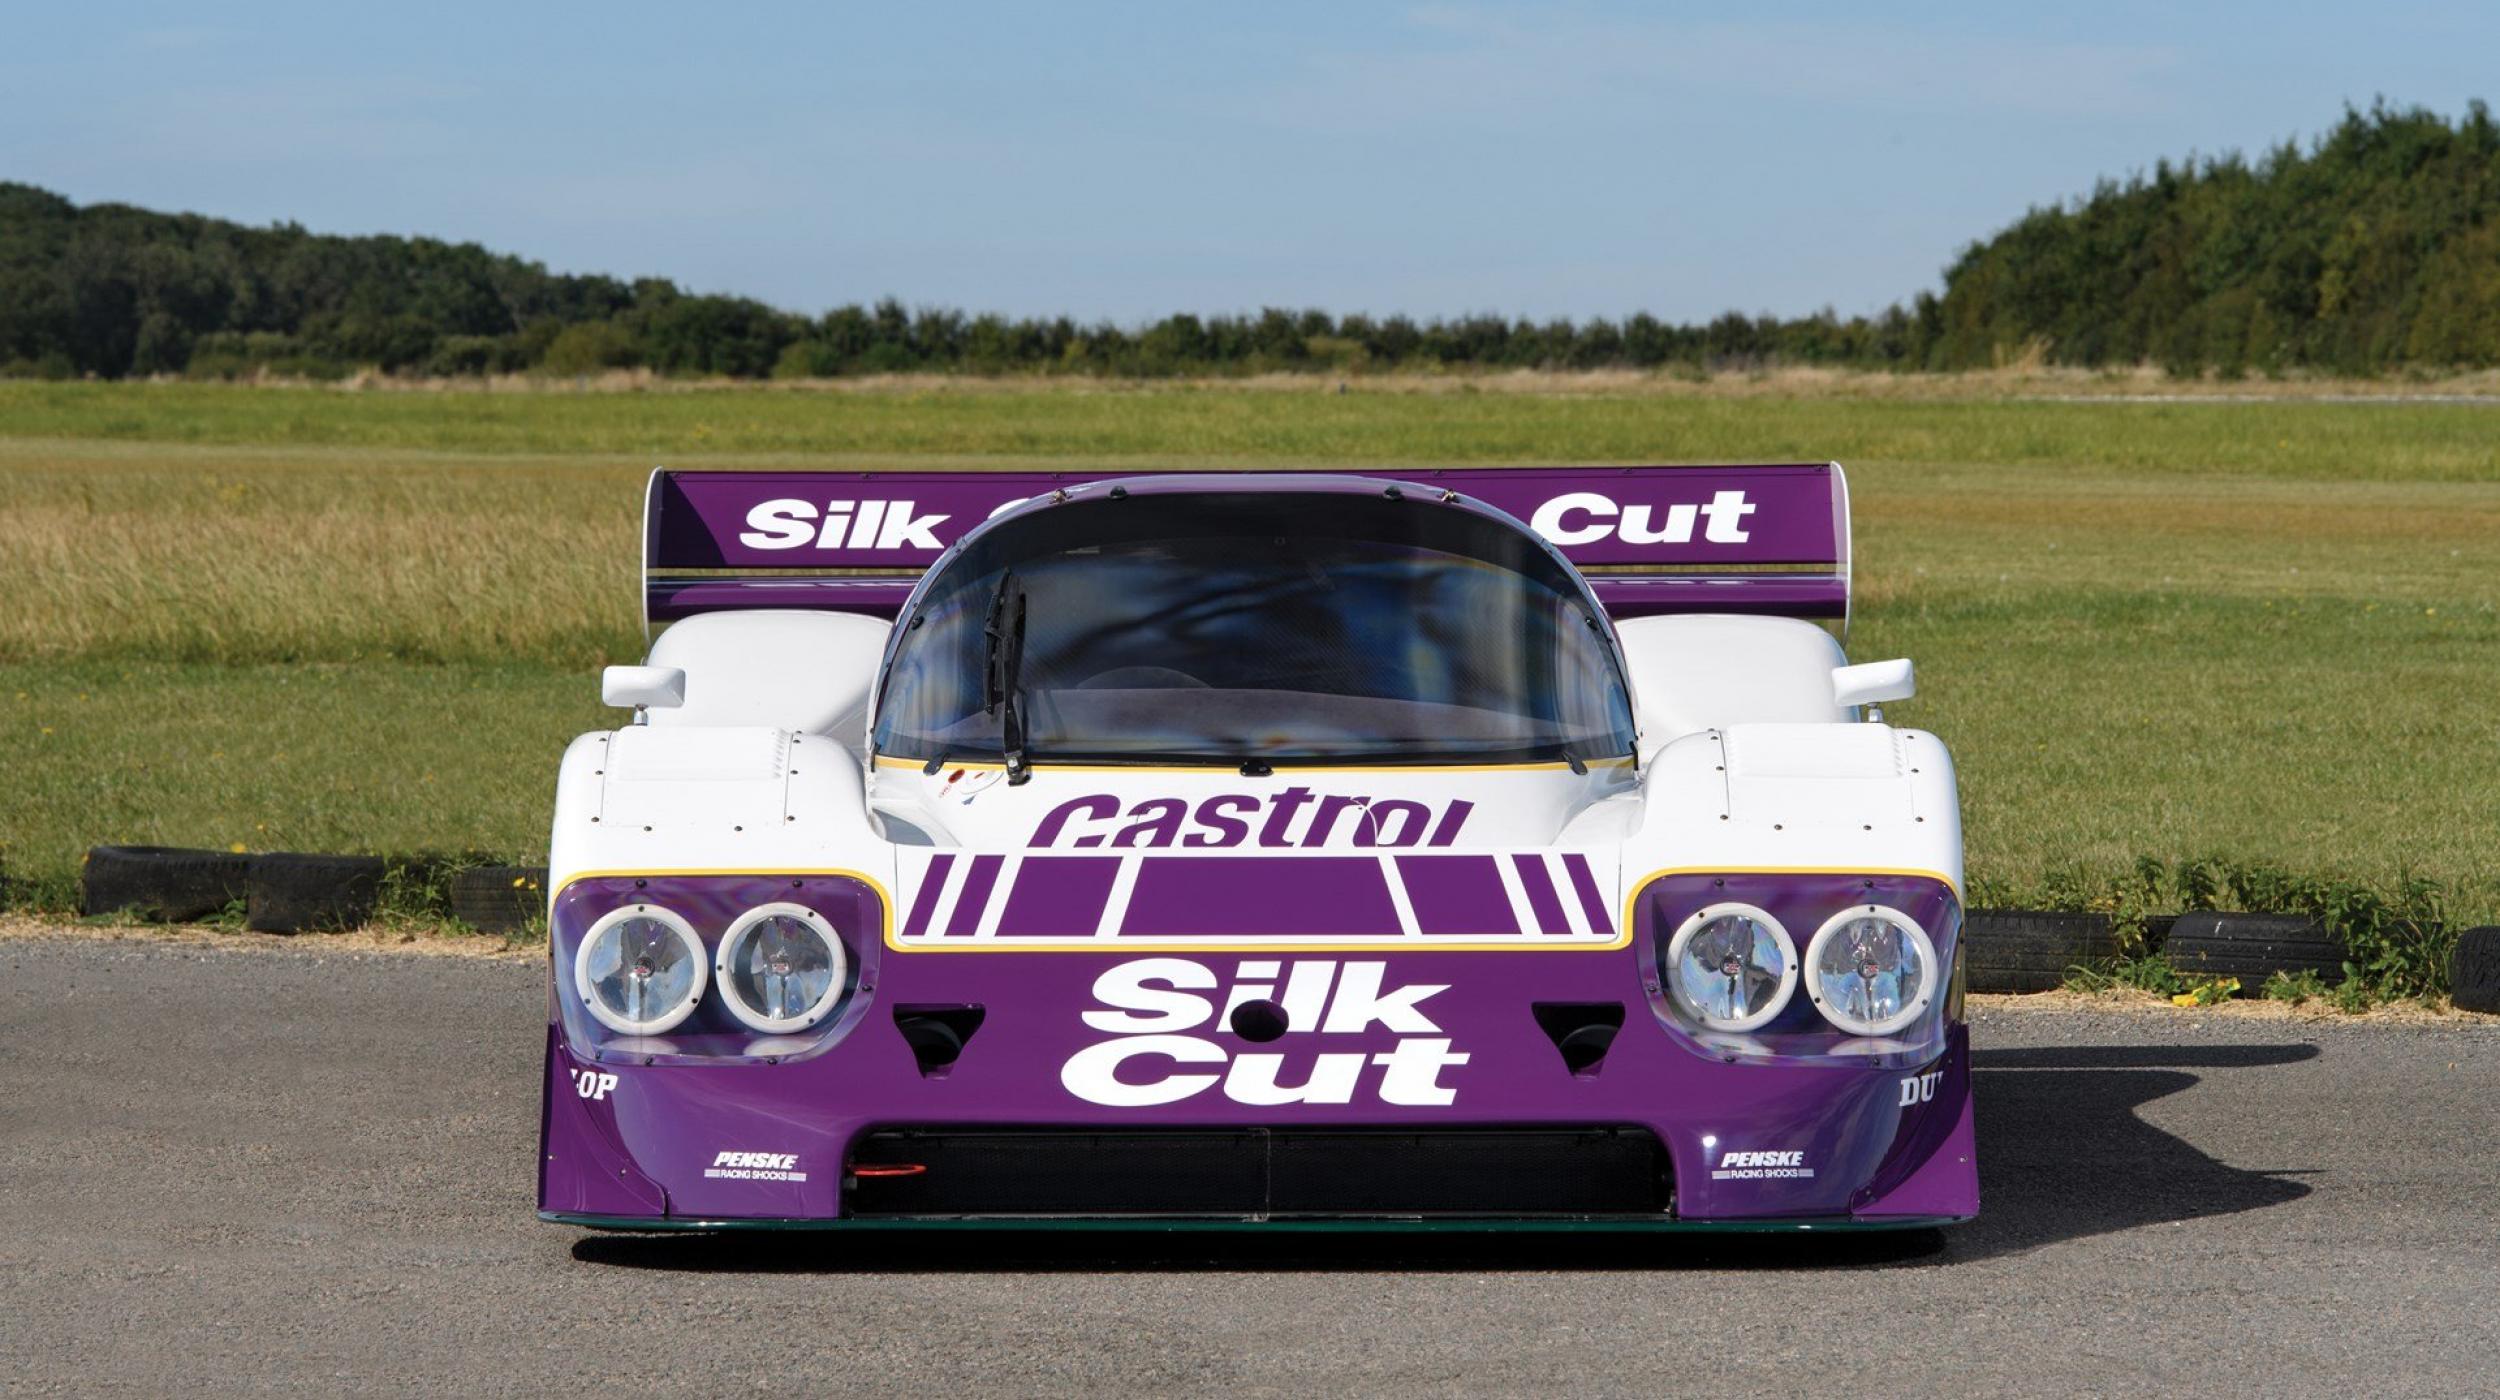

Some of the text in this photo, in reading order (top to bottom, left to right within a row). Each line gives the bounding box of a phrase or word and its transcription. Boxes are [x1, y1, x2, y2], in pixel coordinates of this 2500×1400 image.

[739, 490, 1756, 549] Silk Cut
[1026, 786, 1475, 848] Castrol
[1081, 957, 1452, 1034] Silk
[1060, 1034, 1471, 1107] Cut
[713, 1151, 799, 1170] PENSKE
[720, 1168, 788, 1181] RACING SHOCKS
[1720, 1151, 1804, 1168] PENSKE
[1731, 1168, 1799, 1179] RACING SHOCKS
